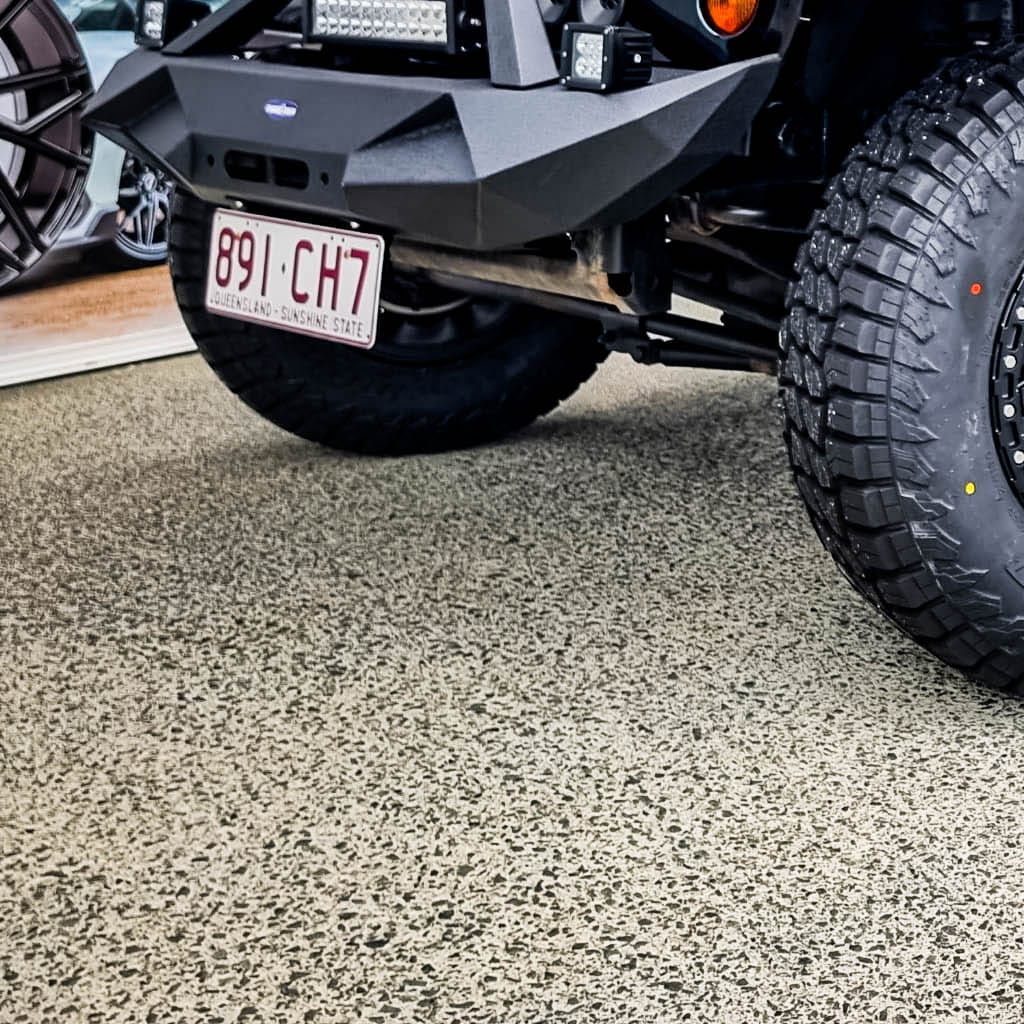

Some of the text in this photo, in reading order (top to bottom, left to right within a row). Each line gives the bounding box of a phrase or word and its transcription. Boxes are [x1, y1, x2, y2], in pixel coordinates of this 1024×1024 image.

[213, 291, 364, 339] QUEENSLAND SUNSHINE STATE
